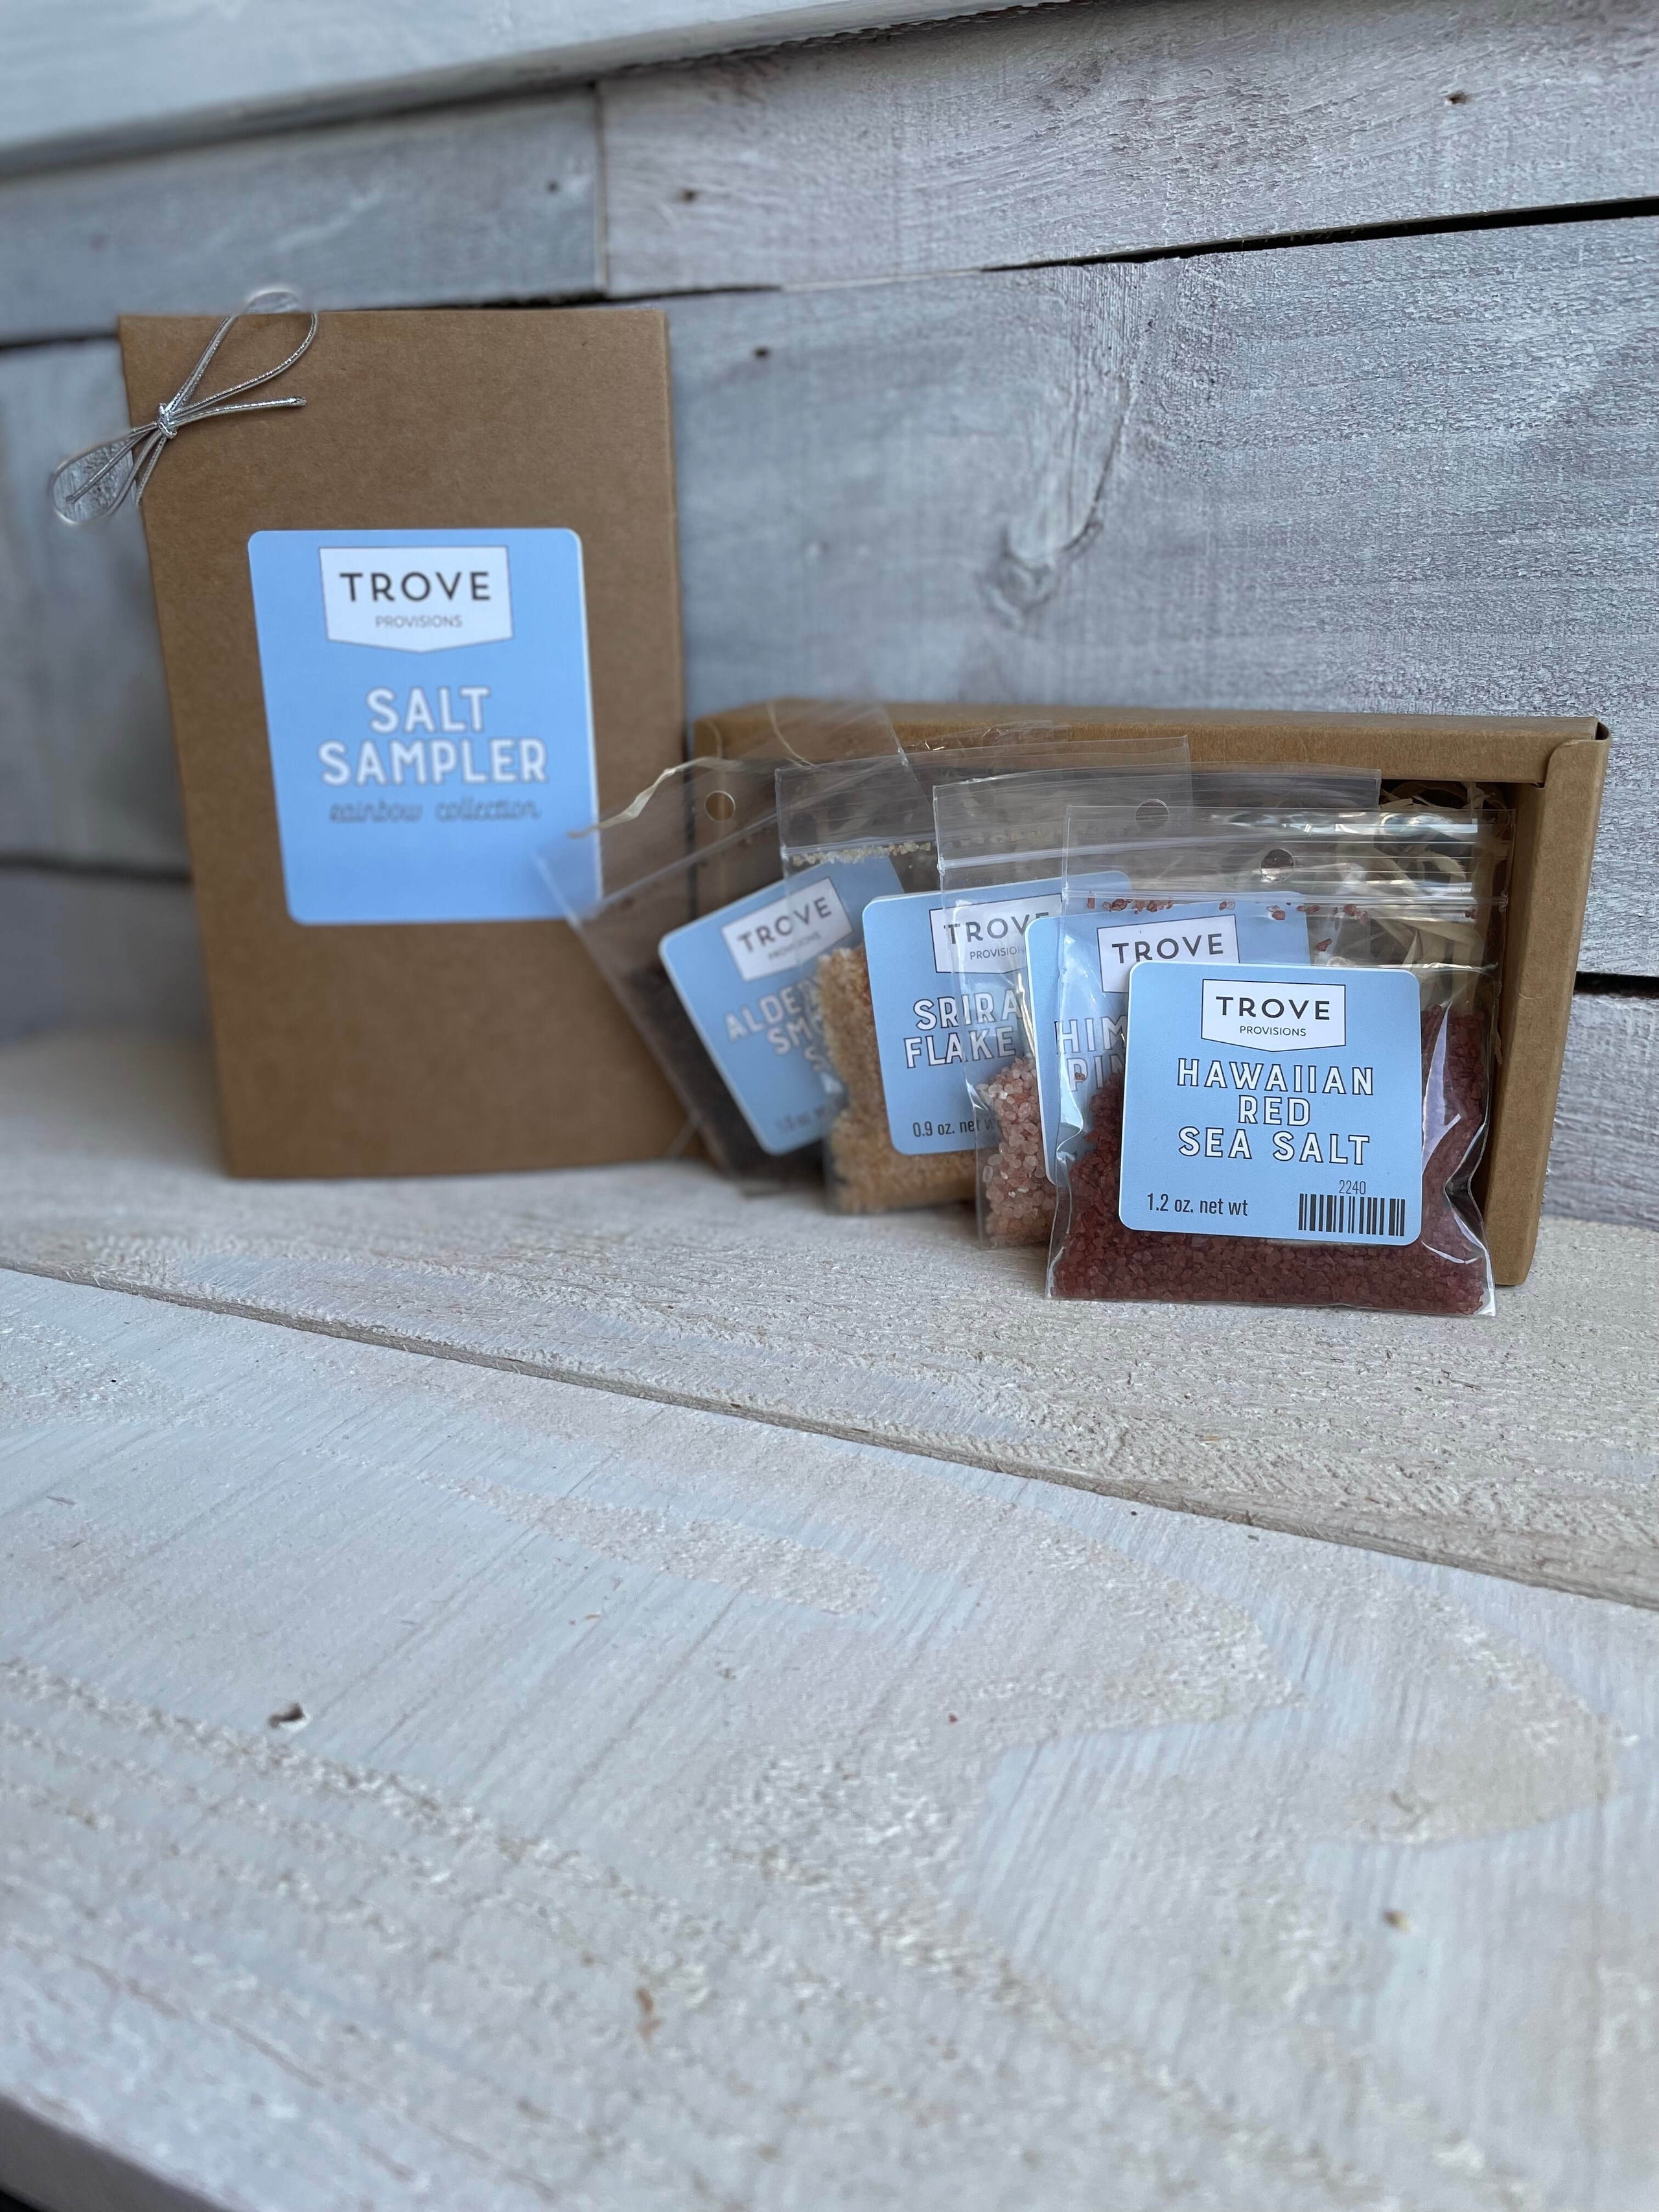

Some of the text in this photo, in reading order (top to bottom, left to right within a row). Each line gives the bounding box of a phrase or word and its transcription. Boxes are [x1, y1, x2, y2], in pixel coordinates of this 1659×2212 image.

[339, 572, 491, 602] TROVE
[375, 614, 463, 629] PROVISIONS
[365, 686, 491, 734] SALT
[318, 738, 549, 787] SAMPLER
[434, 795, 541, 822] collection
[737, 896, 832, 953] TROVE
[944, 911, 1049, 945] TROV
[1111, 933, 1224, 964] TROVE
[1216, 996, 1330, 1021] TROVE
[1240, 1025, 1306, 1037] PROVISIONS
[904, 1025, 1017, 1069] FLAKE
[1177, 1058, 1373, 1096] HAWAIIAN
[1238, 1095, 1311, 1127] RED
[912, 1121, 933, 1137] 0.9
[937, 1123, 956, 1135] oz.
[1178, 1126, 1370, 1165] SEA SALT
[1338, 1180, 1366, 1195] 2240
[1147, 1193, 1248, 1217] 1.2 oz. net wt
